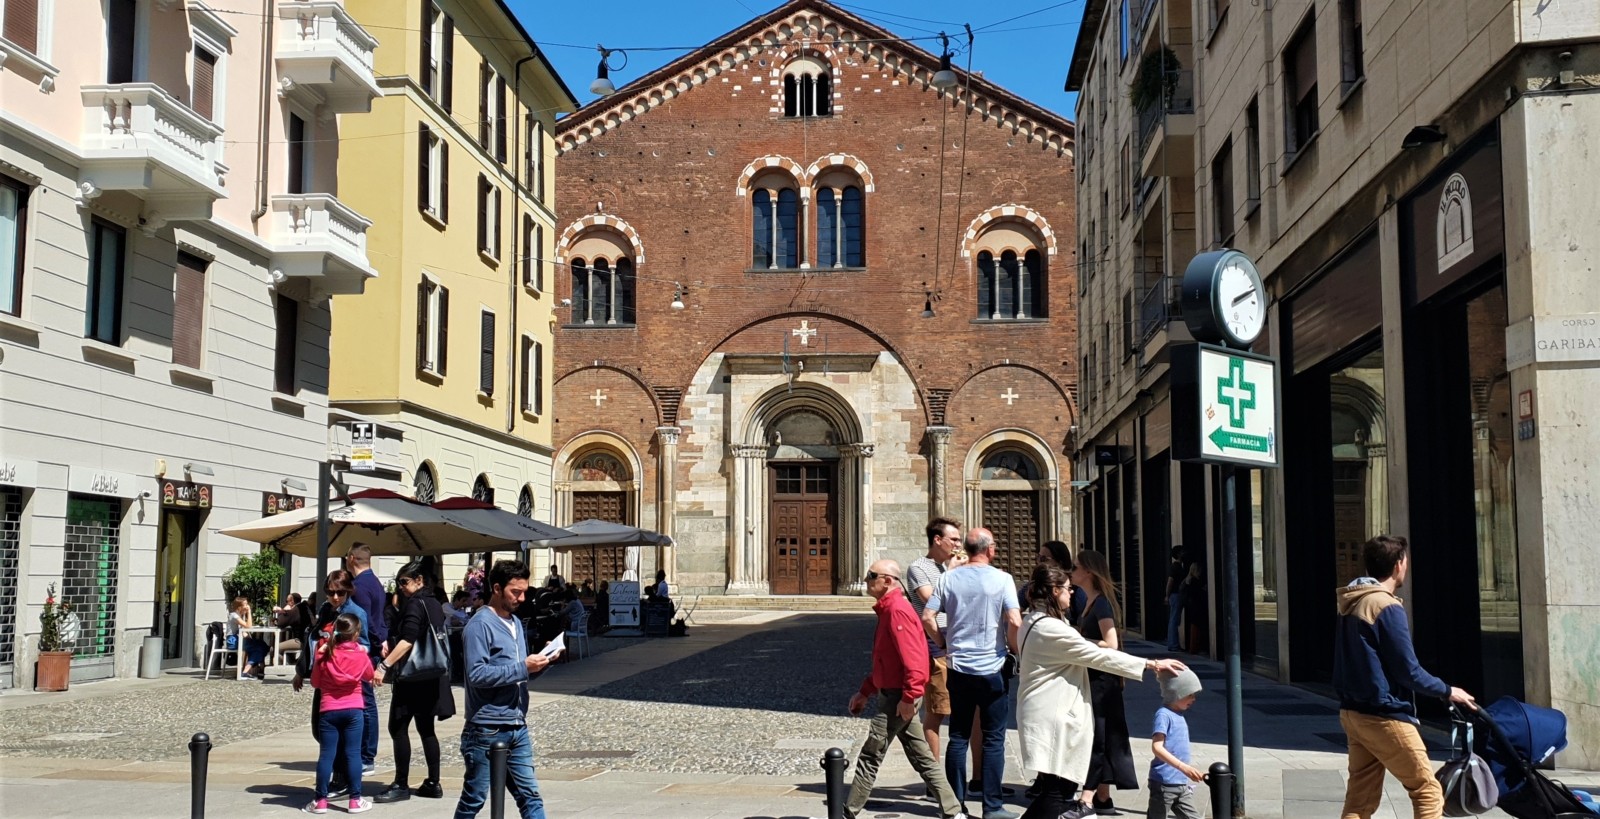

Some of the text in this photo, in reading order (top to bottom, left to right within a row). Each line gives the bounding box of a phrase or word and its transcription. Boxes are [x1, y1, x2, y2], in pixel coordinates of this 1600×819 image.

[1562, 318, 1596, 326] CORSO
[1537, 337, 1600, 350] GARIBA
[356, 424, 369, 437] T
[1230, 436, 1261, 447] FARMACIA
